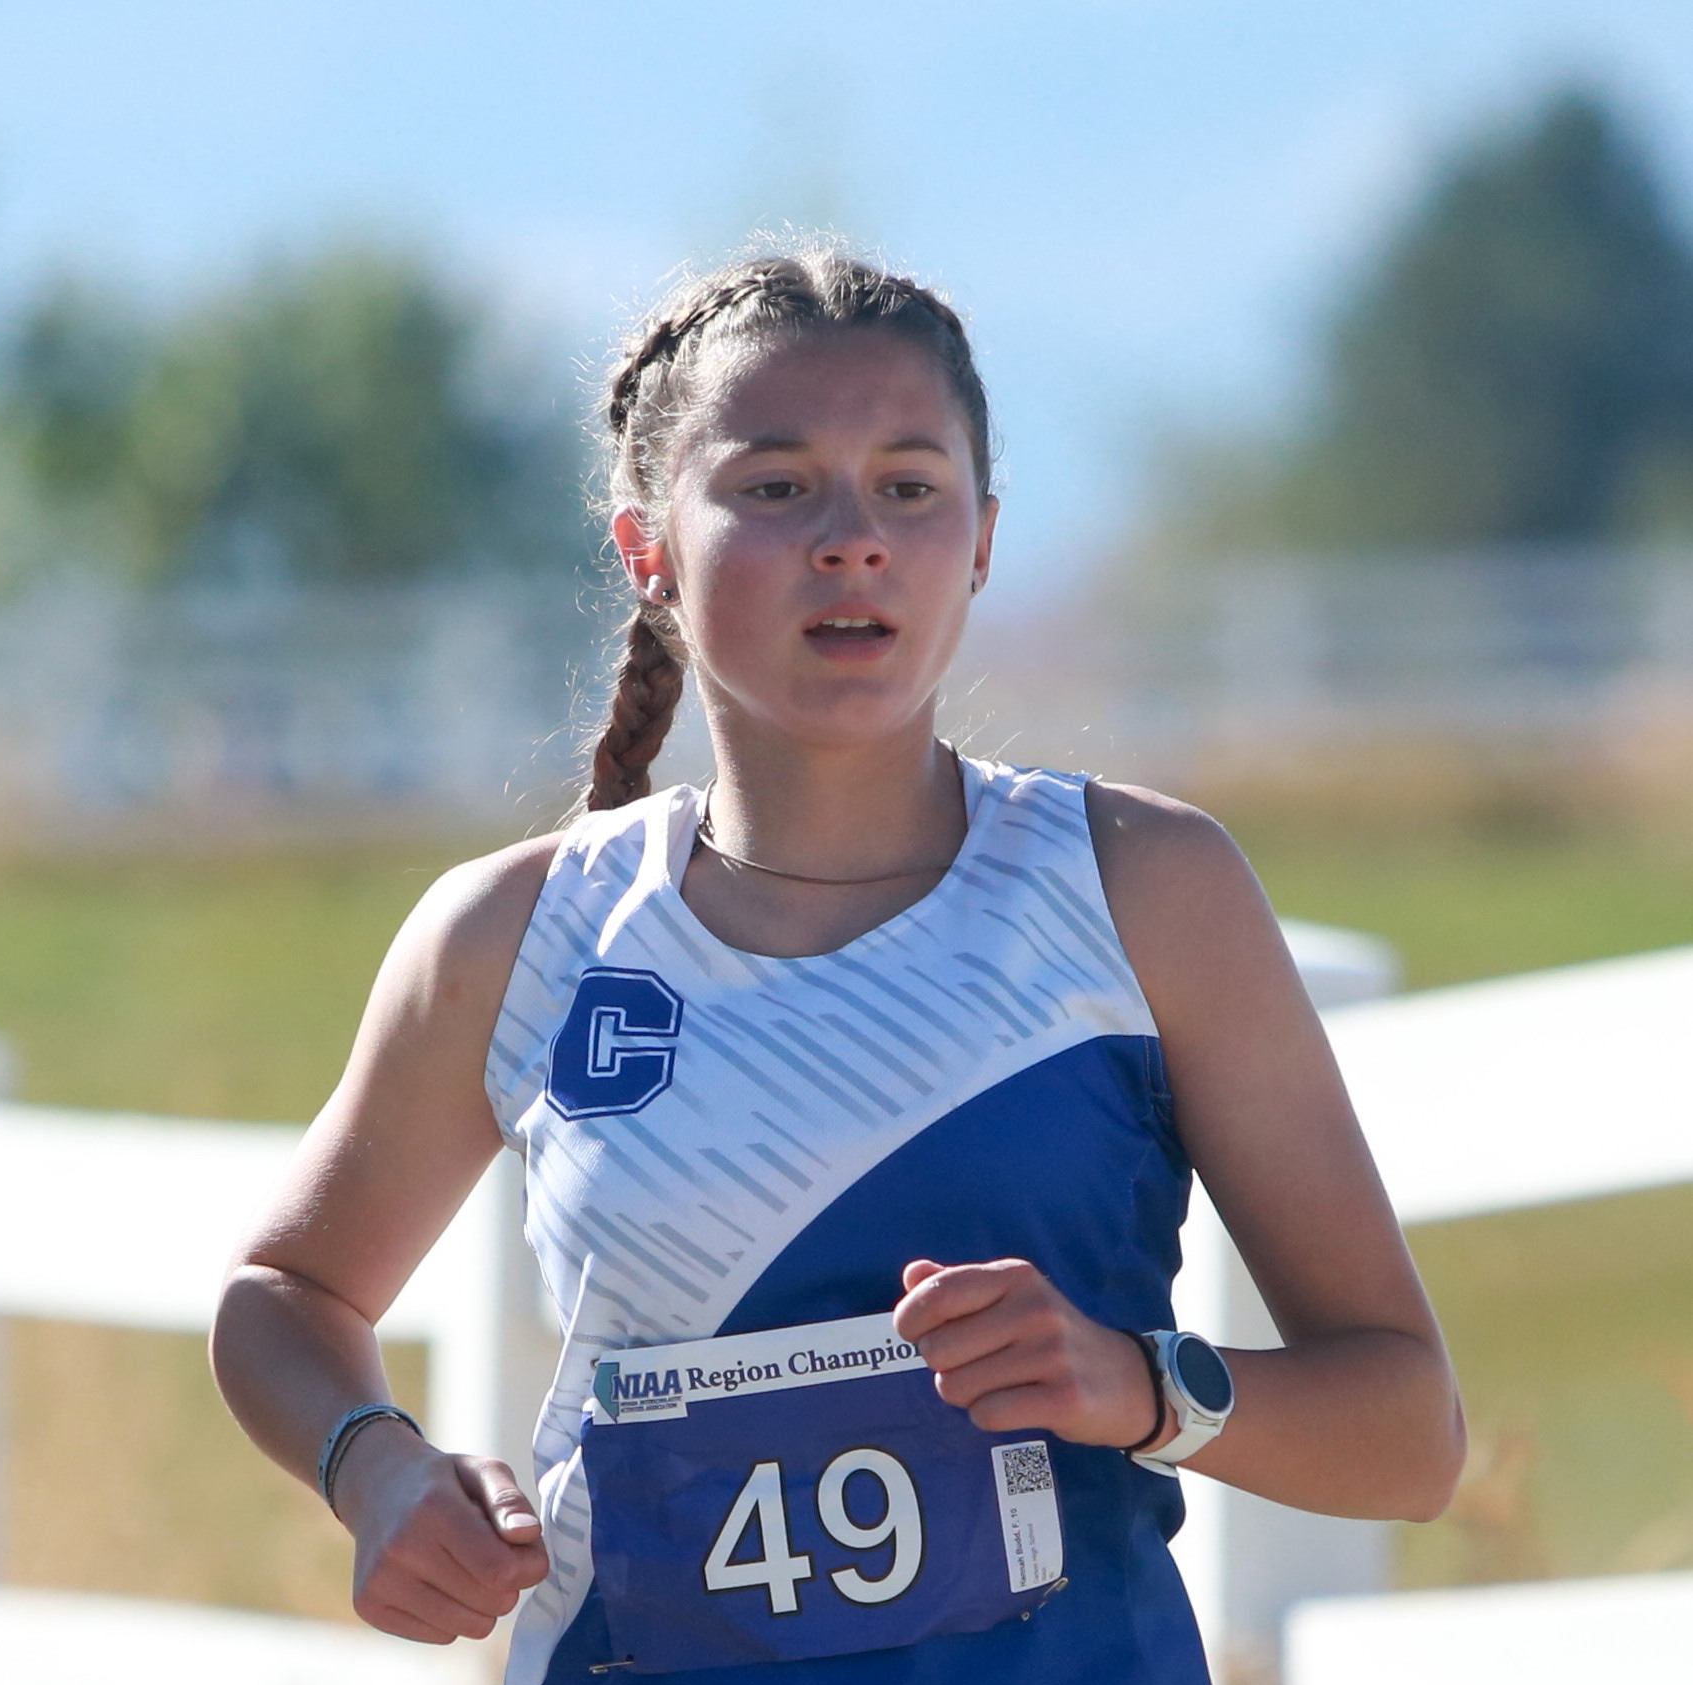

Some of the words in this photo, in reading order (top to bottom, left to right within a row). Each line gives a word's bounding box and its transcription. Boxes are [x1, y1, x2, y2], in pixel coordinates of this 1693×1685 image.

[545, 966, 684, 1122] C
[612, 1369, 683, 1400] NIAA
[686, 1360, 782, 1391] Region
[703, 1445, 927, 1616] 49
